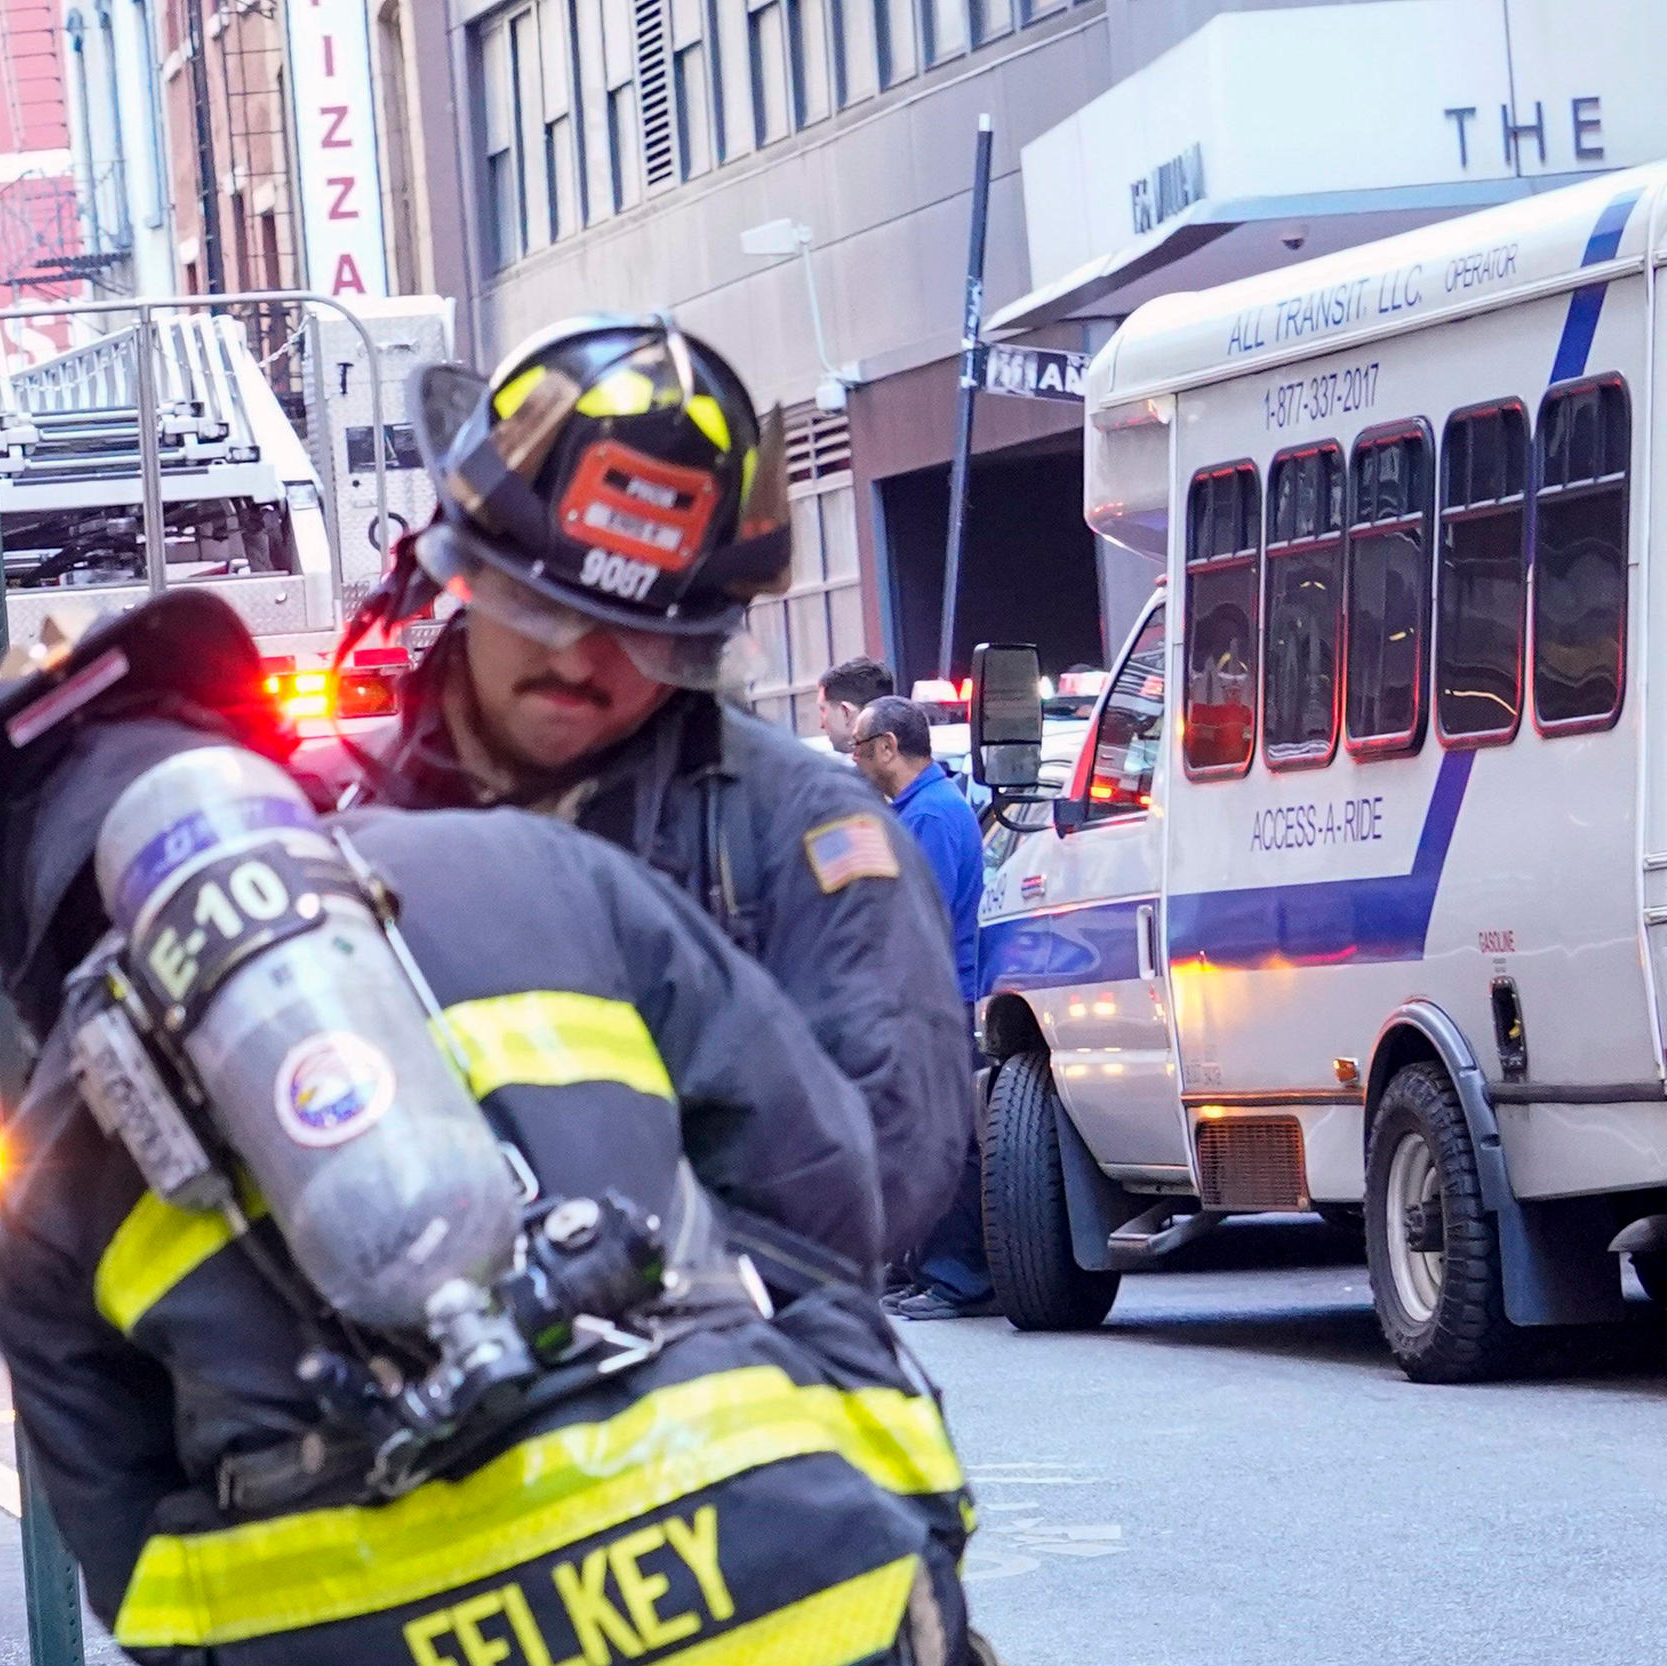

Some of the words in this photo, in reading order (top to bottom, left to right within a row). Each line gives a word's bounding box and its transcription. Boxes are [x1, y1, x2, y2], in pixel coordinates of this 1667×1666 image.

[312, 0, 366, 296] IZZA
[1443, 95, 1605, 170] THE
[1227, 311, 1267, 356] ALL
[1444, 243, 1520, 293] OPERATOR
[1038, 362, 1087, 397] AN
[1264, 362, 1380, 431] 1-877-337-2017
[1250, 797, 1384, 852] ACCESS-A-RIDE
[147, 861, 290, 1001] E-10
